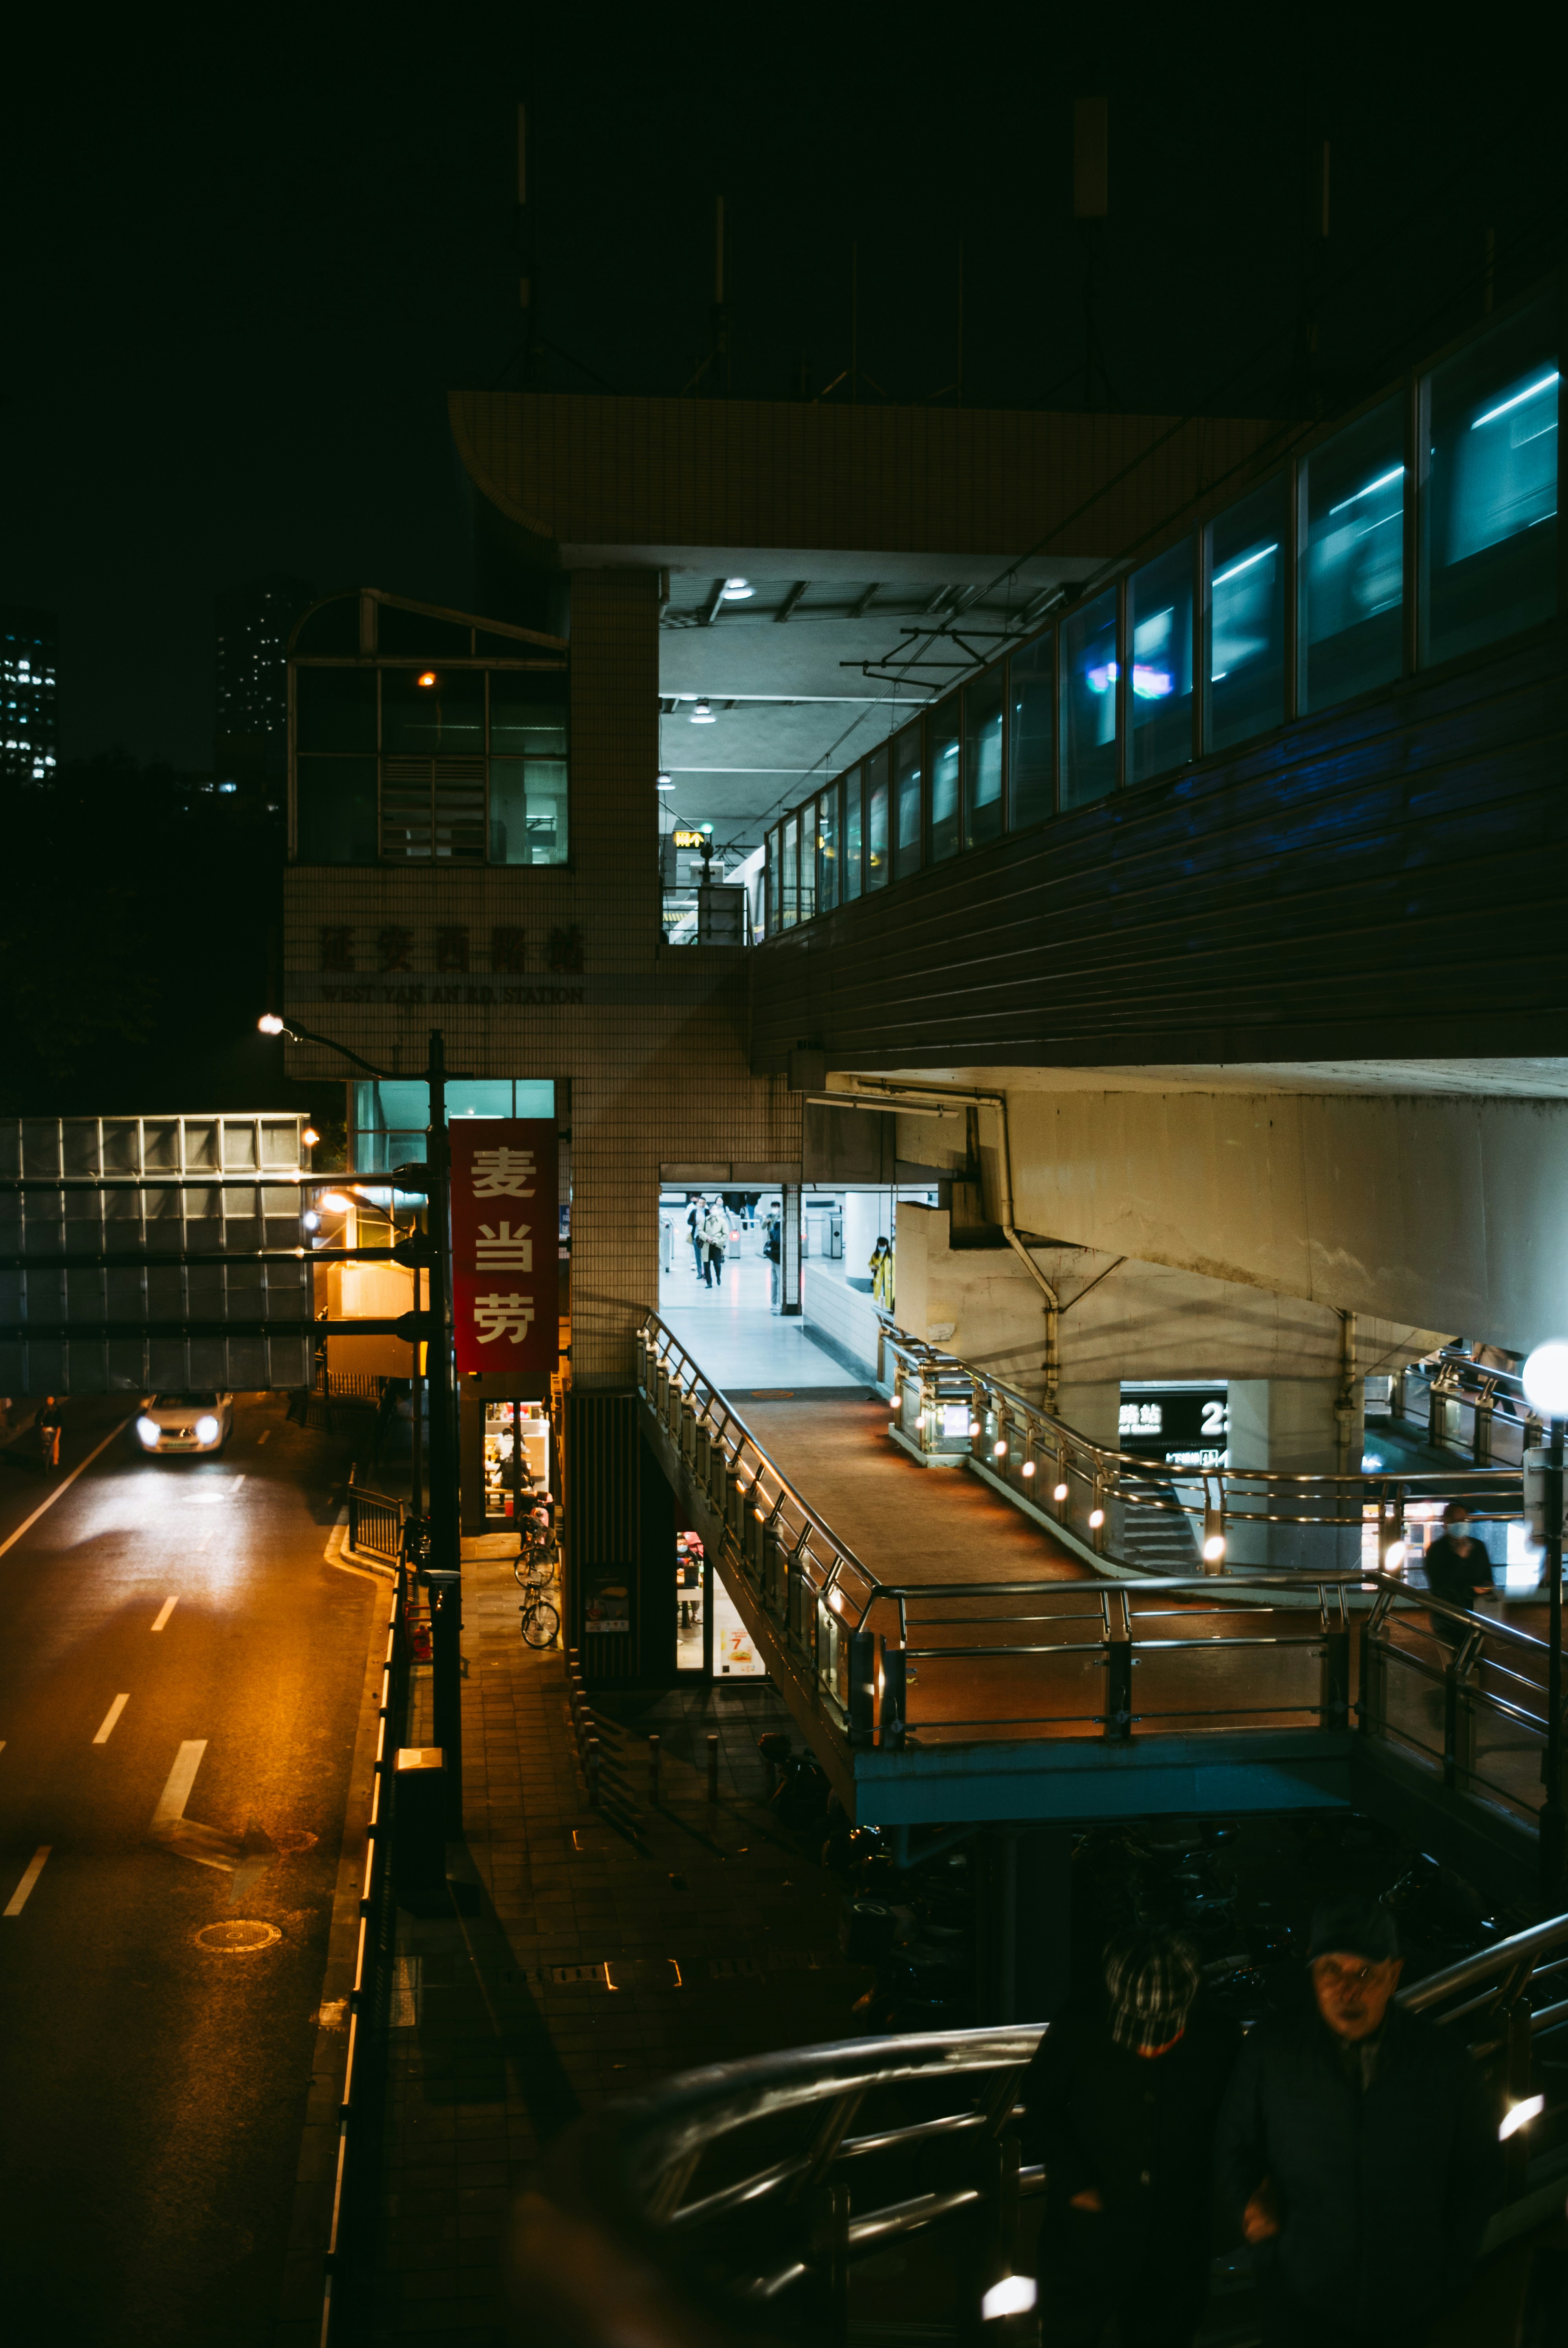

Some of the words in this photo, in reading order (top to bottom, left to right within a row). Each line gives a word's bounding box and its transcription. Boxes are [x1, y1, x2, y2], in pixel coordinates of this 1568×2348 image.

[321, 925, 583, 972] 延安西路站
[322, 985, 374, 1003] WEST
[504, 985, 584, 1003] STATION
[471, 1147, 537, 1344] 麦当劳
[1201, 1402, 1223, 1432] 2
